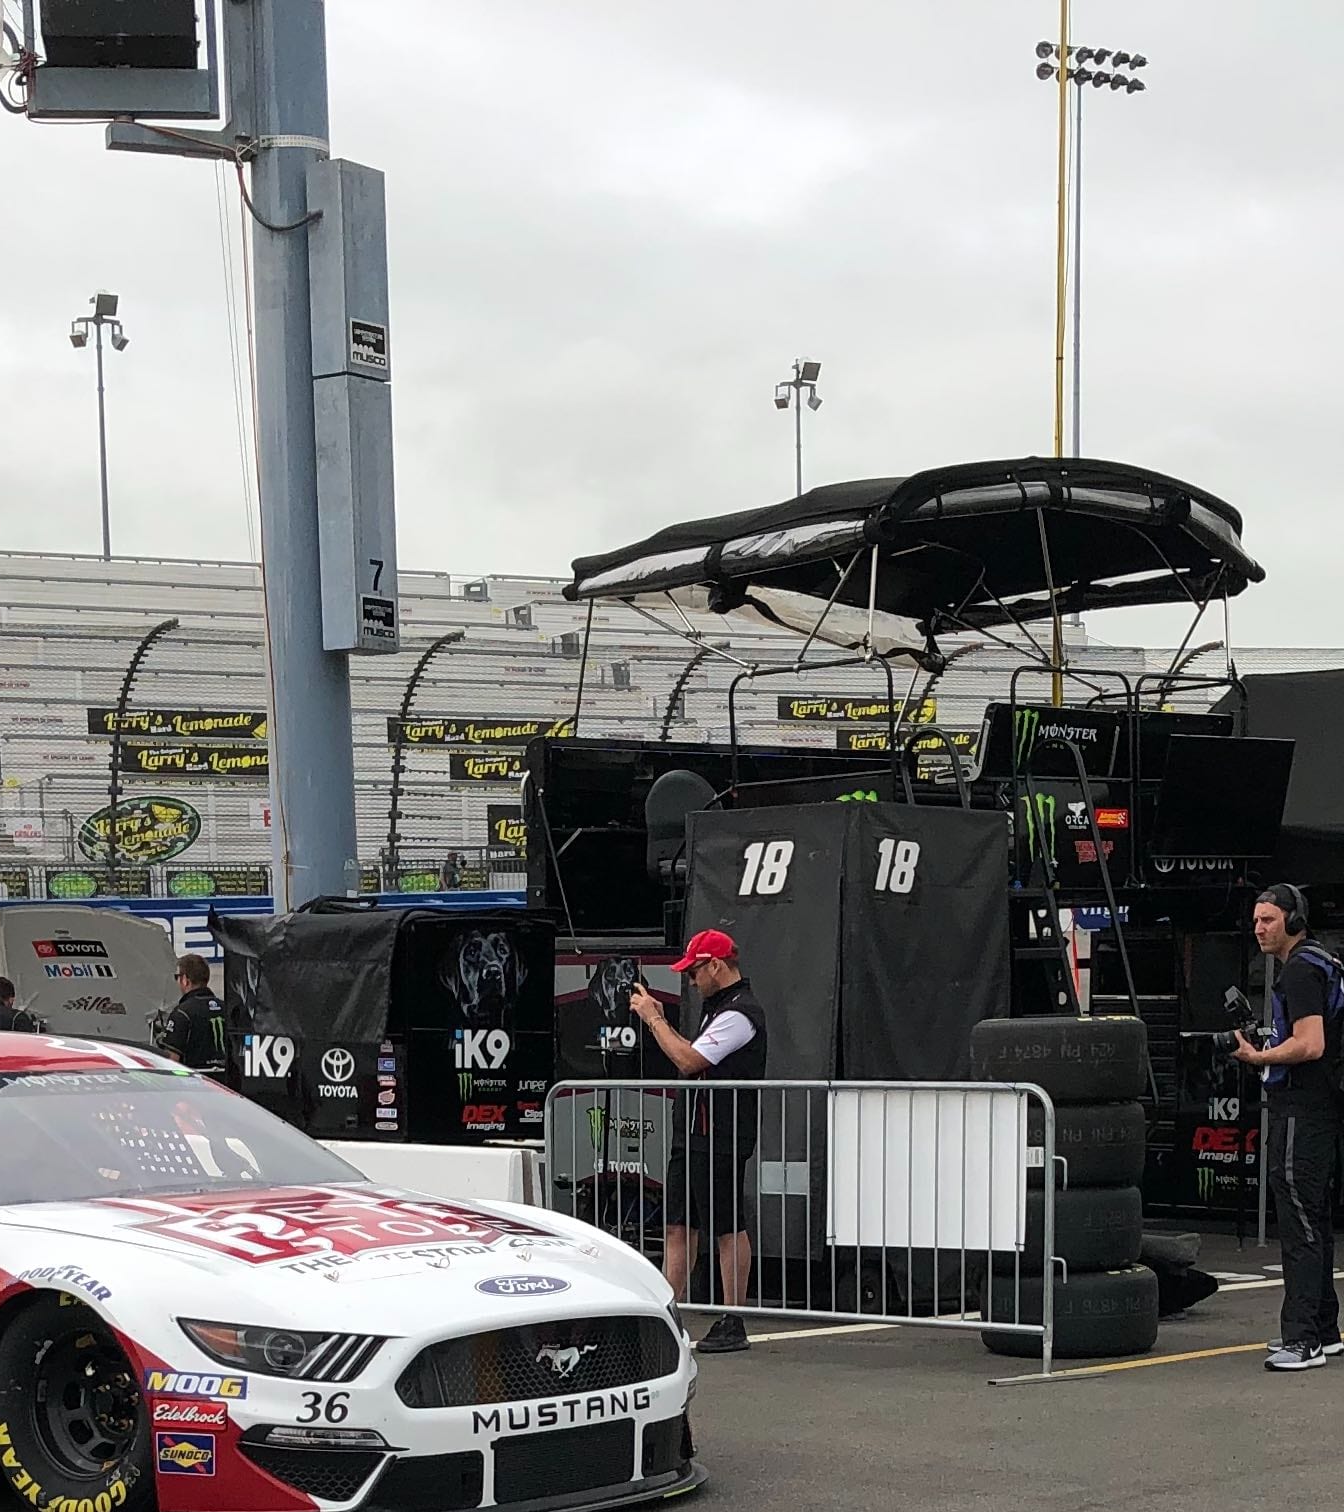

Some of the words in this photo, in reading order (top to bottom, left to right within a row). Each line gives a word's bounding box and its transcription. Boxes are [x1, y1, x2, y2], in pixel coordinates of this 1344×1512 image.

[369, 558, 384, 591] 7
[844, 699, 903, 720] Lemonde
[172, 713, 252, 736] Lemonade
[465, 721, 539, 743] Lemonade
[1038, 723, 1098, 742] MONSTER
[137, 749, 199, 770] Larry's
[464, 758, 521, 778] Larry's
[1065, 815, 1090, 825] ORCA
[739, 840, 795, 896] 18
[875, 838, 921, 894] 18
[57, 943, 106, 954] TOYOTA
[44, 964, 94, 978] Mobil
[244, 1035, 295, 1078] iK9
[455, 1028, 511, 1069] iK9
[2, 1073, 131, 1089] MONSTER
[318, 1084, 358, 1098] TOYOTA
[461, 1104, 509, 1123] DEX
[524, 1109, 544, 1118] Clips
[1208, 1097, 1240, 1121] iK9
[608, 1160, 649, 1175] TOYOTA
[1198, 1150, 1256, 1164] Imagig
[14, 1264, 113, 1302] OODYEAR
[494, 1274, 556, 1295] Ford
[146, 1371, 244, 1397] MOOG
[152, 1404, 225, 1426] Edelbrock
[296, 1390, 351, 1424] 36
[472, 1387, 652, 1436] MUSTANG
[159, 1448, 212, 1462] SUNOCO
